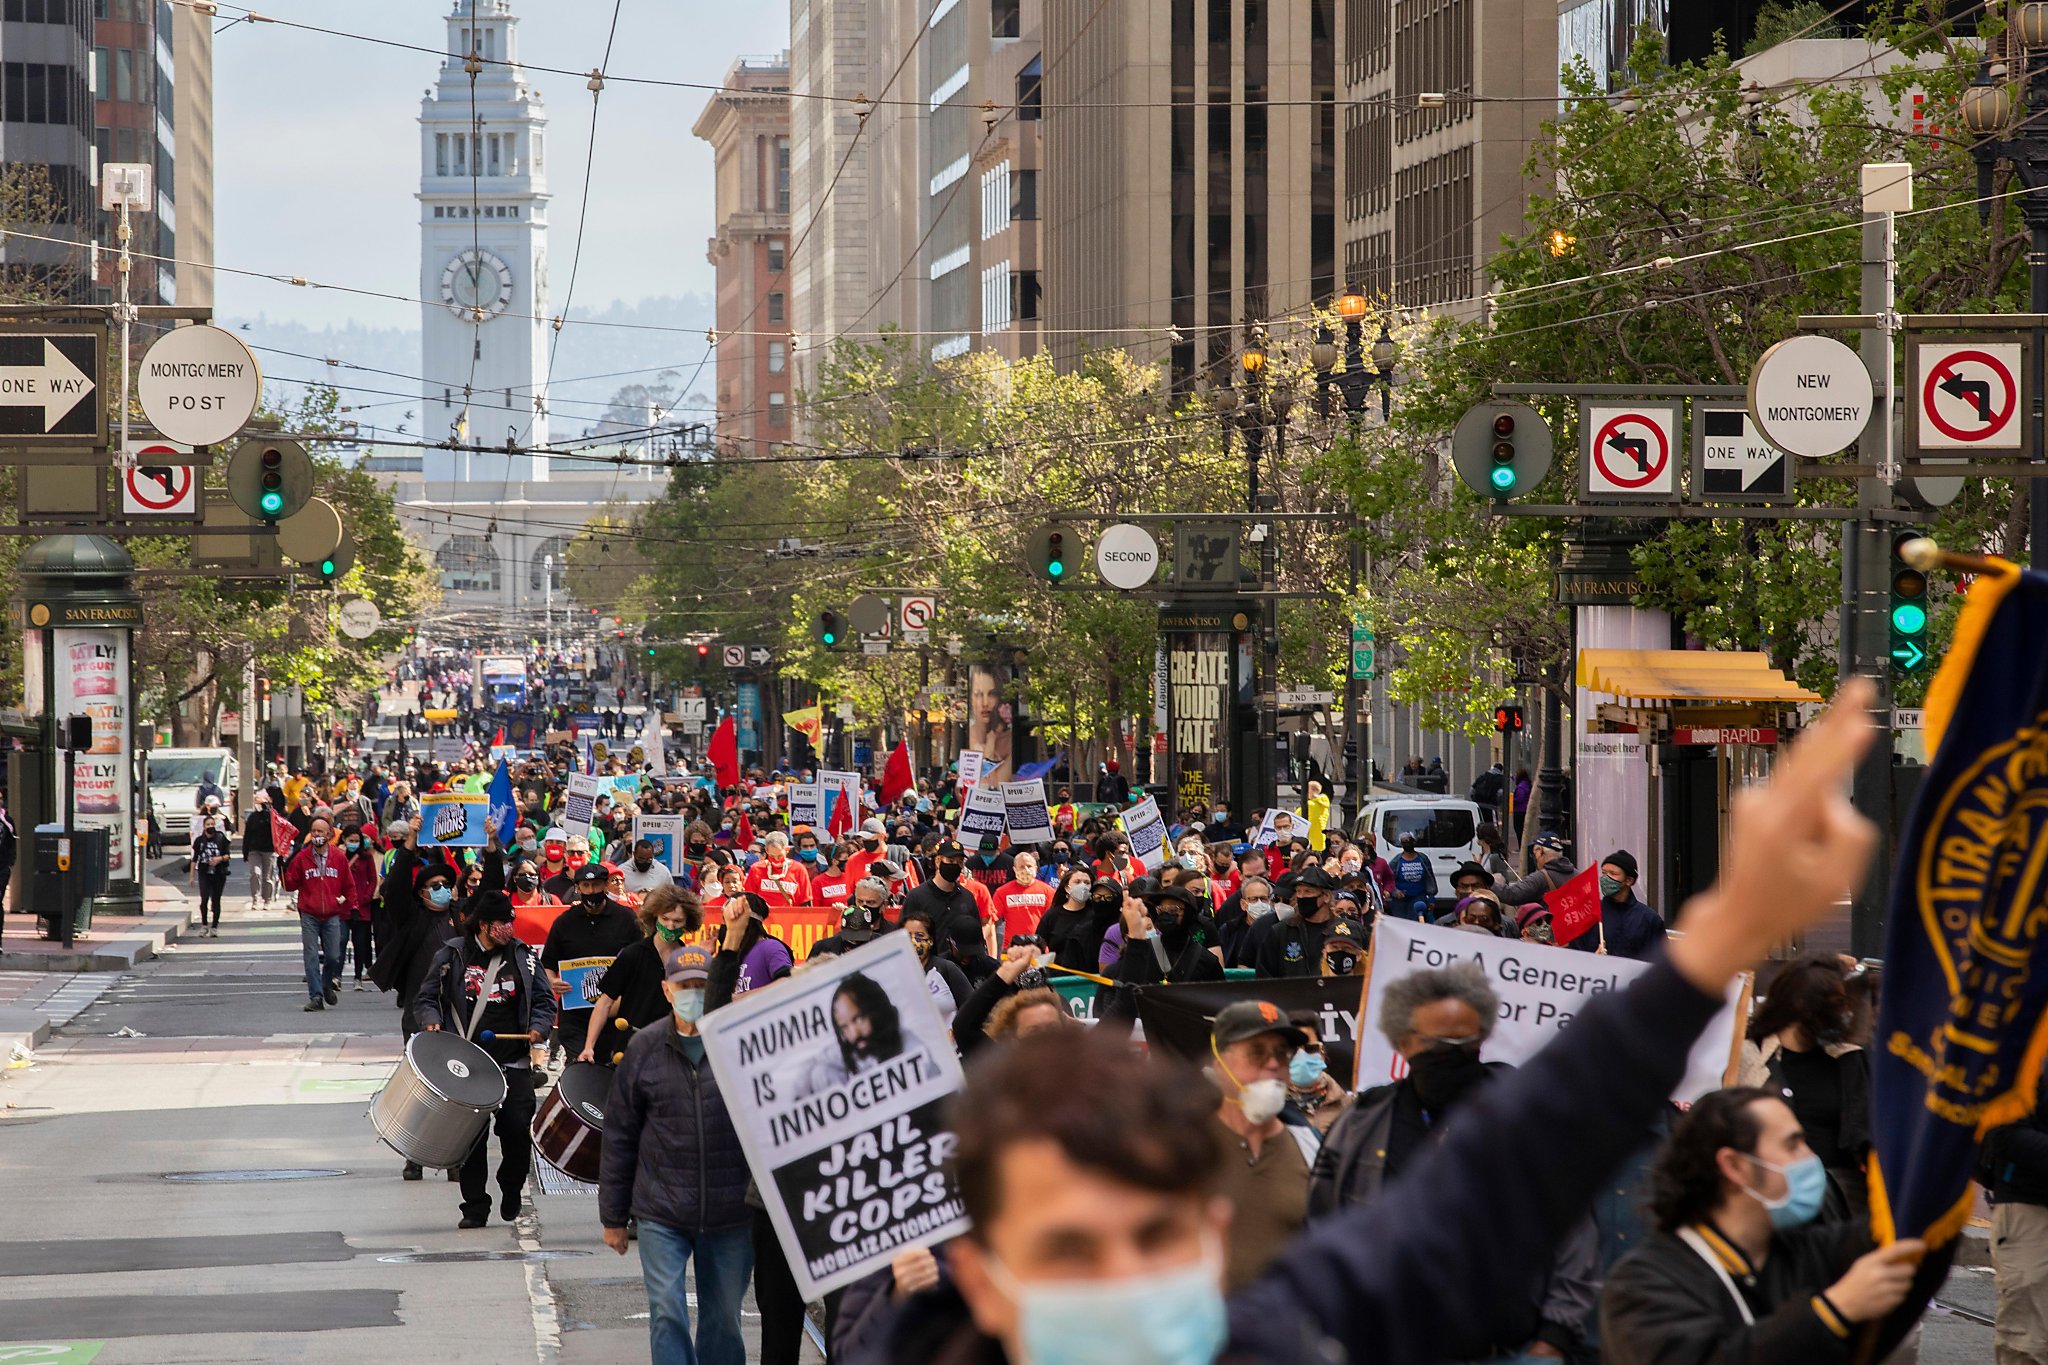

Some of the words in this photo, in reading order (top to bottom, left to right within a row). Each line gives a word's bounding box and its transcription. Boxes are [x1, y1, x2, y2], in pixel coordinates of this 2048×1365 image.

[151, 363, 244, 378] MONTGOMERY
[2, 379, 36, 393] ONE
[50, 379, 84, 393] WAY
[1797, 375, 1830, 388] NEW
[169, 396, 226, 410] POST
[1768, 407, 1860, 421] MONTGOMERY
[1707, 447, 1736, 459] ONE
[1746, 447, 1775, 459] WAY
[1105, 551, 1151, 562] SECOND
[1565, 582, 1581, 594] SAN
[66, 609, 88, 620] SAN
[1170, 651, 1229, 685] CREATE
[1173, 685, 1219, 719] YOUR
[1289, 694, 1307, 702] 2ND
[1899, 713, 1919, 725] NEW
[1176, 720, 1218, 754] FATE.
[1721, 729, 1760, 743] RAPID
[1183, 770, 1203, 782] THE
[1178, 784, 1212, 795] WHITE
[432, 815, 465, 838] UNIONS
[642, 820, 661, 829] OPEIU
[739, 1005, 829, 1066] MUMIA
[752, 1070, 777, 1107] IS
[769, 1053, 923, 1147] INNOCENT
[818, 1113, 922, 1177] JAIL
